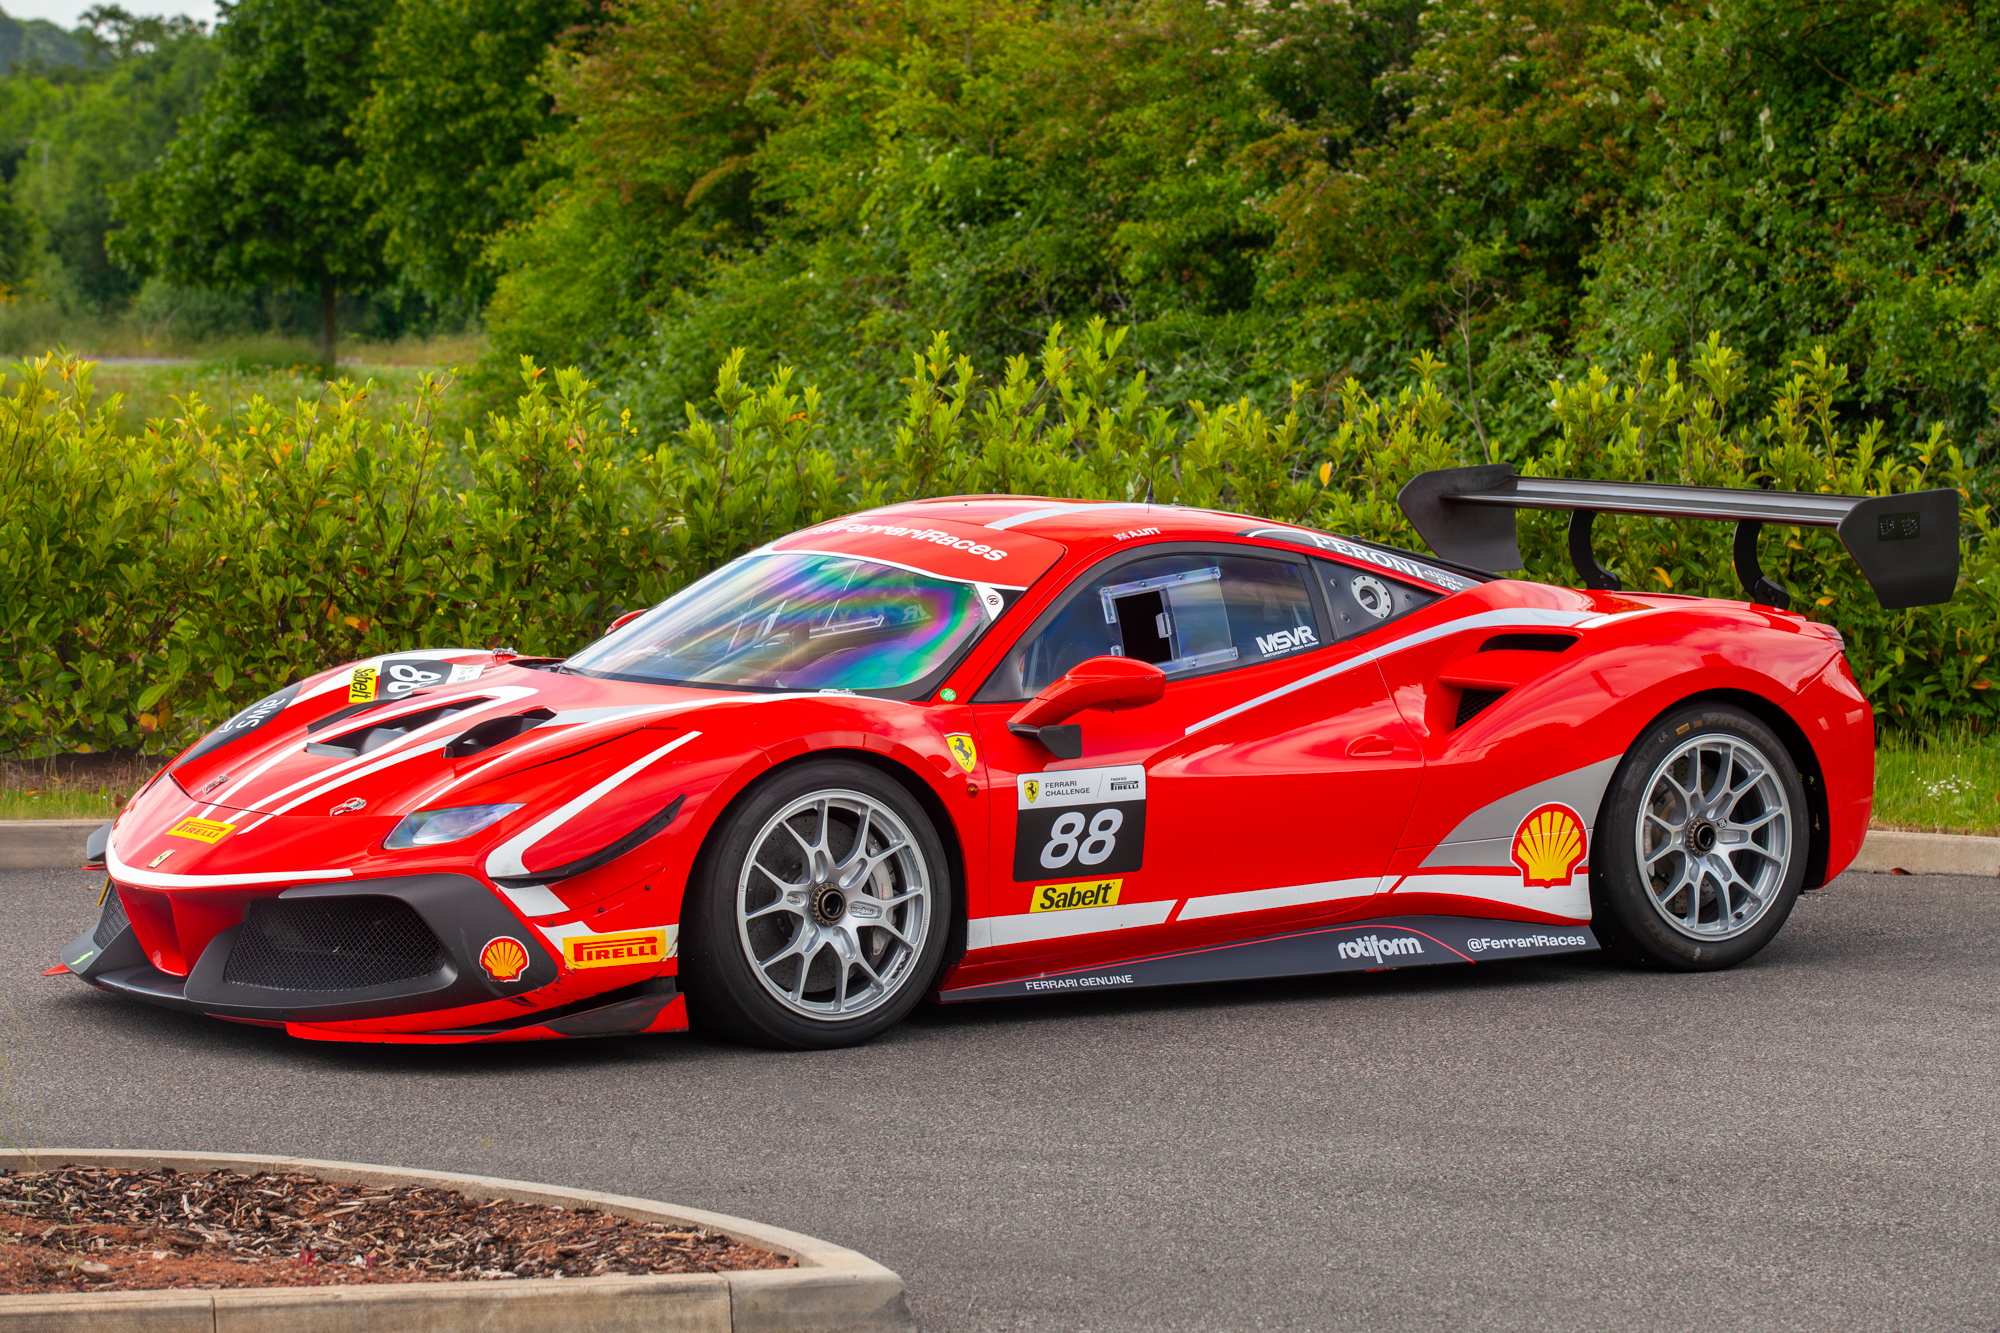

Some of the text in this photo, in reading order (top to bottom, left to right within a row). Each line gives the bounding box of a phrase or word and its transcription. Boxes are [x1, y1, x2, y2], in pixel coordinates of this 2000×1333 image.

[813, 523, 1008, 561] @FerrariRaces
[1309, 534, 1425, 580] PERONI
[1255, 625, 1317, 655] MSVR
[1263, 648, 1290, 658] MOTORSPORT
[351, 668, 375, 699] Sabelt
[387, 664, 441, 693] 88
[236, 698, 286, 729] aws
[1045, 781, 1077, 789] FERRARI
[1045, 787, 1091, 797] CHALLENGE
[1110, 780, 1139, 791] PIRELLI
[175, 820, 226, 838] PIRELLI
[1040, 808, 1123, 869] 88
[1039, 883, 1113, 909] Sabelt
[573, 936, 658, 963] PIRELLI
[1337, 934, 1424, 963] rotiform
[1466, 935, 1587, 953] @FerrariRaces
[1025, 974, 1134, 991] FERRARI GENUINE
